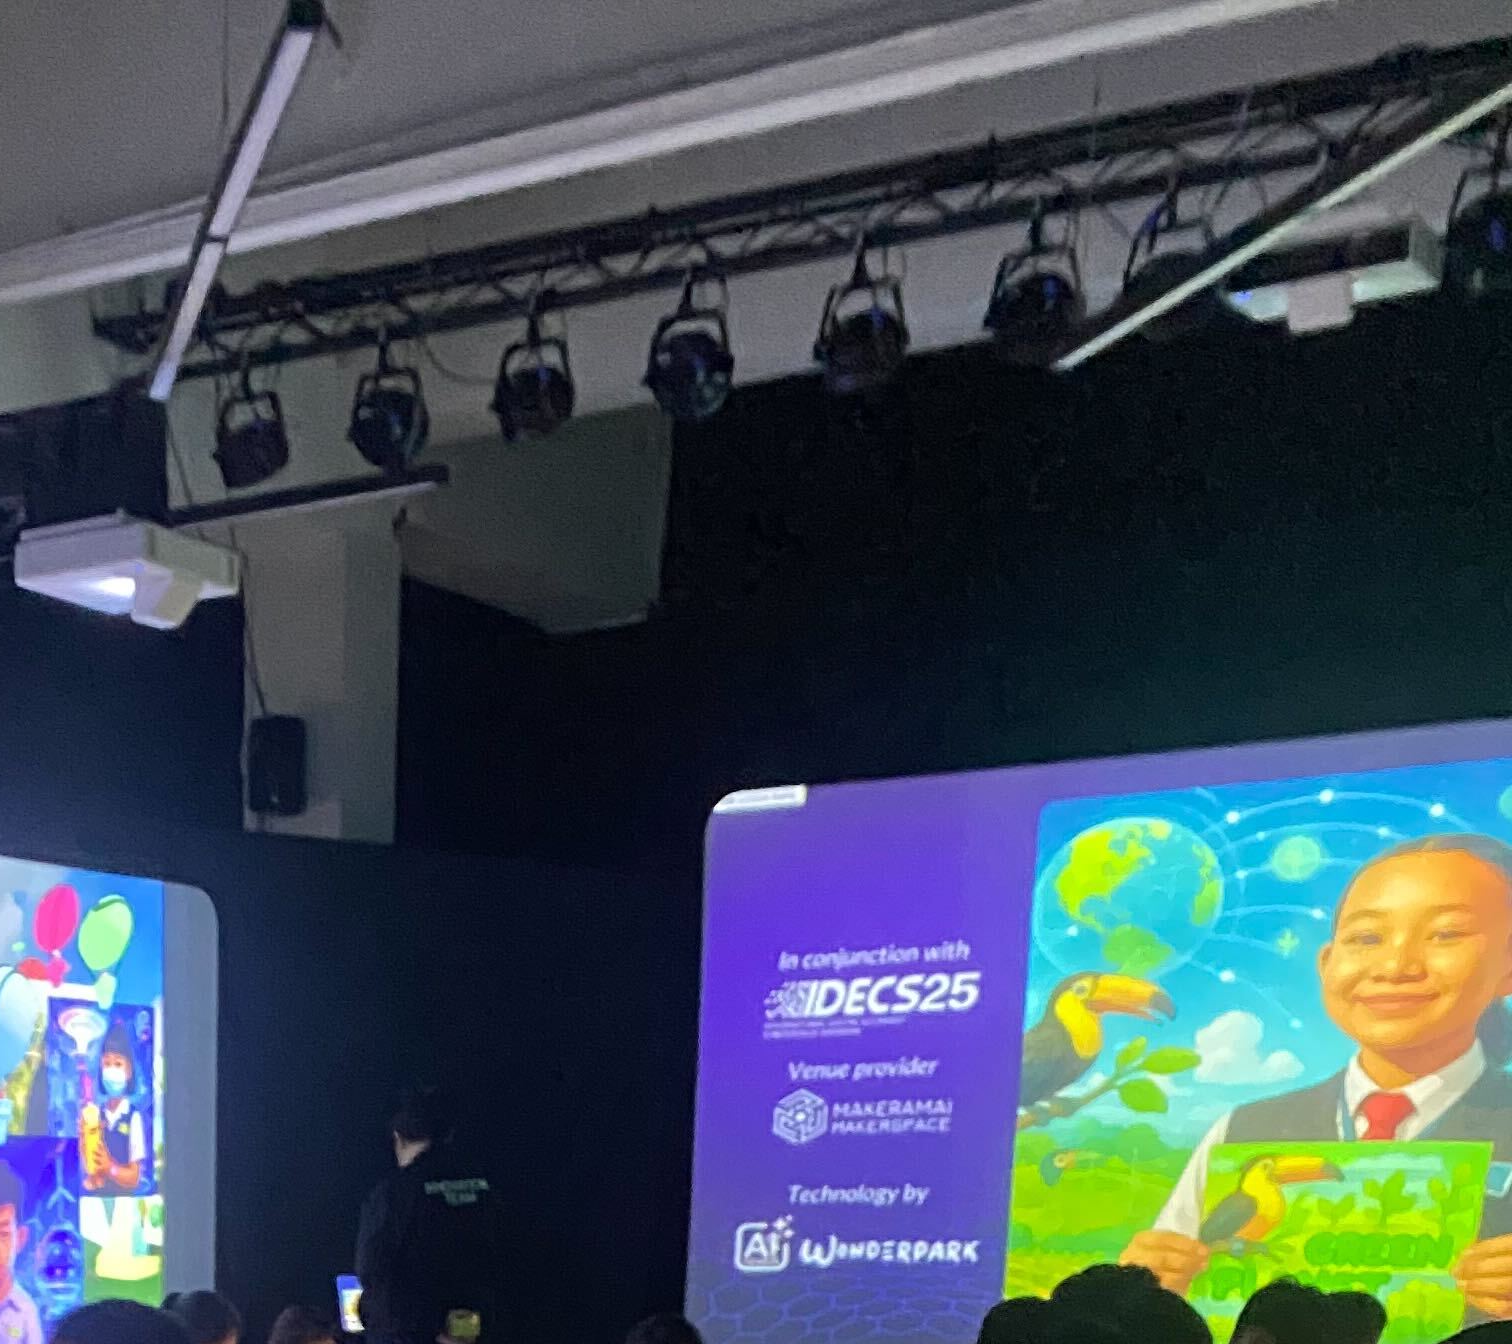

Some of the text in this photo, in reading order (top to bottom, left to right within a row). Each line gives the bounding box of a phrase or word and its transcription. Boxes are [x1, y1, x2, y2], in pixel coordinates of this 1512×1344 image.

[778, 939, 971, 972] In conjunction with
[803, 971, 982, 1018] IDECS25
[788, 1056, 939, 1081] Venue provider
[787, 1183, 930, 1206] Technology by
